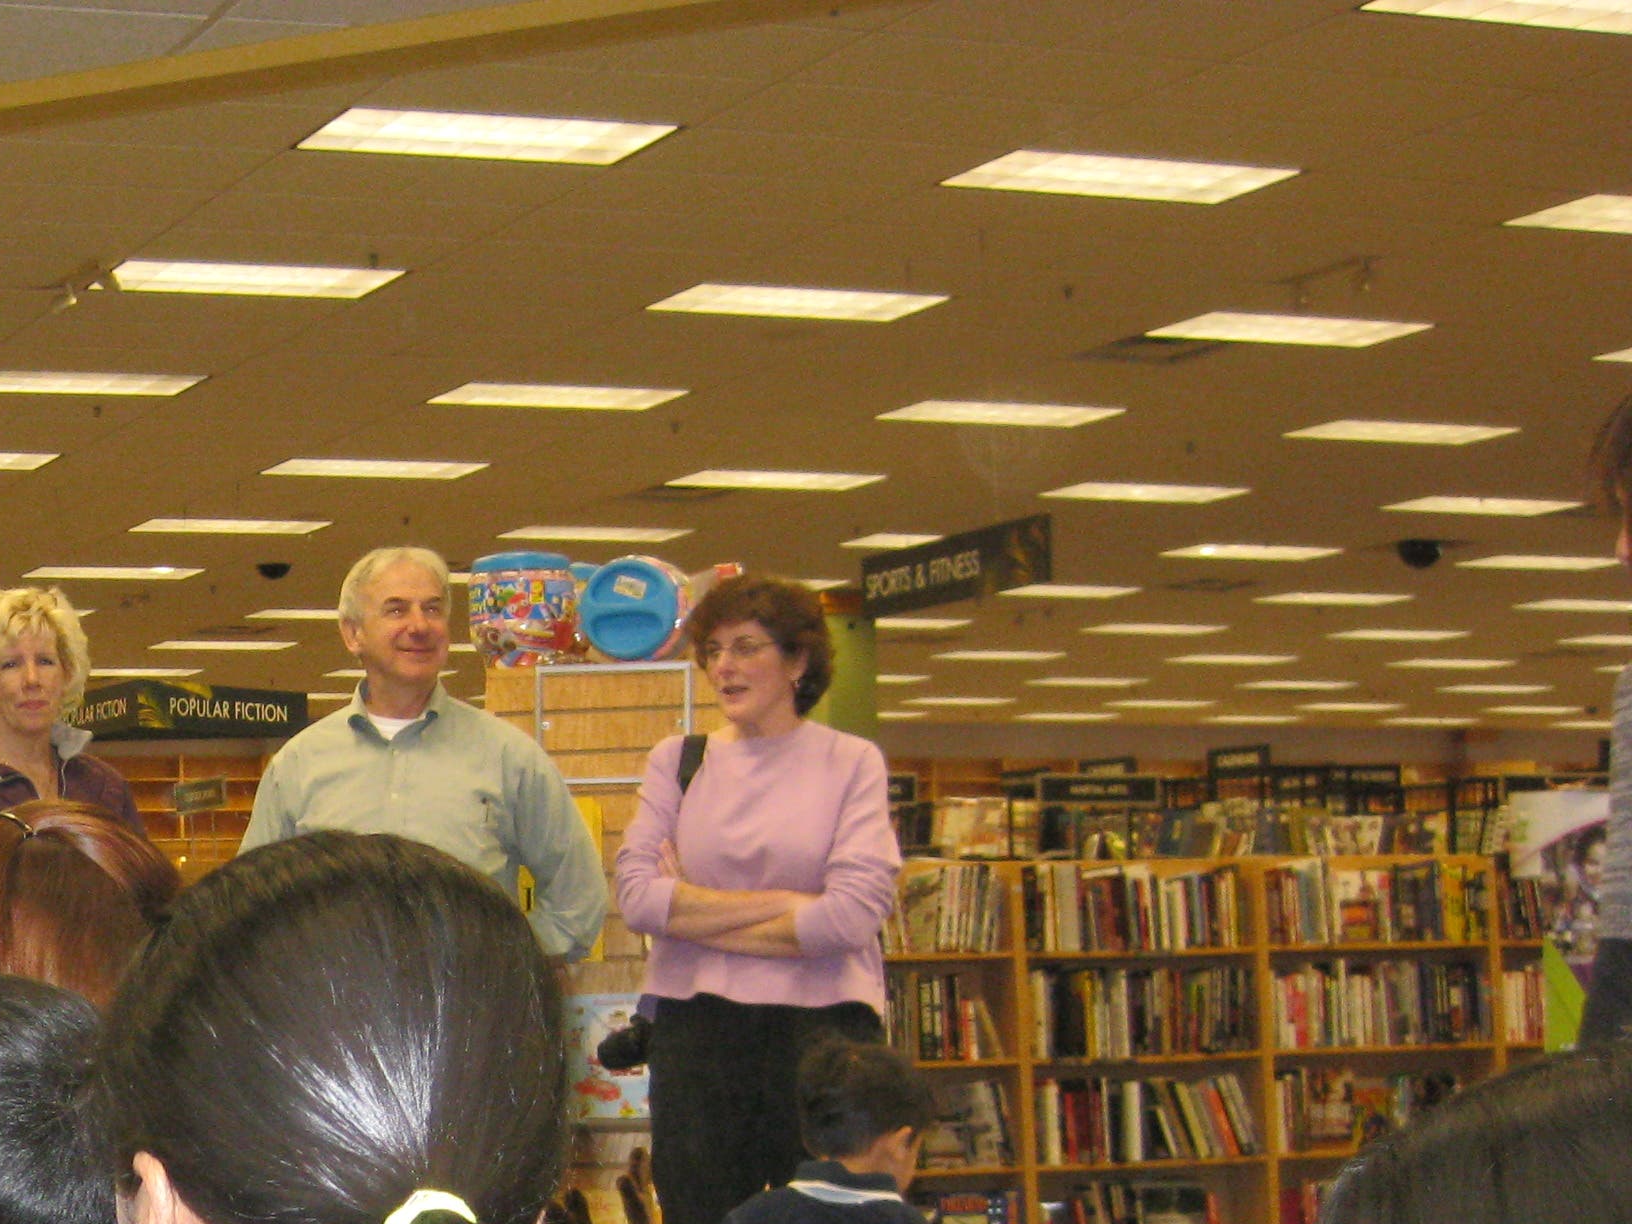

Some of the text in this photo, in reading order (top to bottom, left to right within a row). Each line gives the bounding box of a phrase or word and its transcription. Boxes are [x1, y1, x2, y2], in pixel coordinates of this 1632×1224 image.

[865, 548, 980, 600] SPORTS & FITNESS
[96, 697, 127, 720] FICTION
[169, 697, 288, 722] POPULAR FICTION
